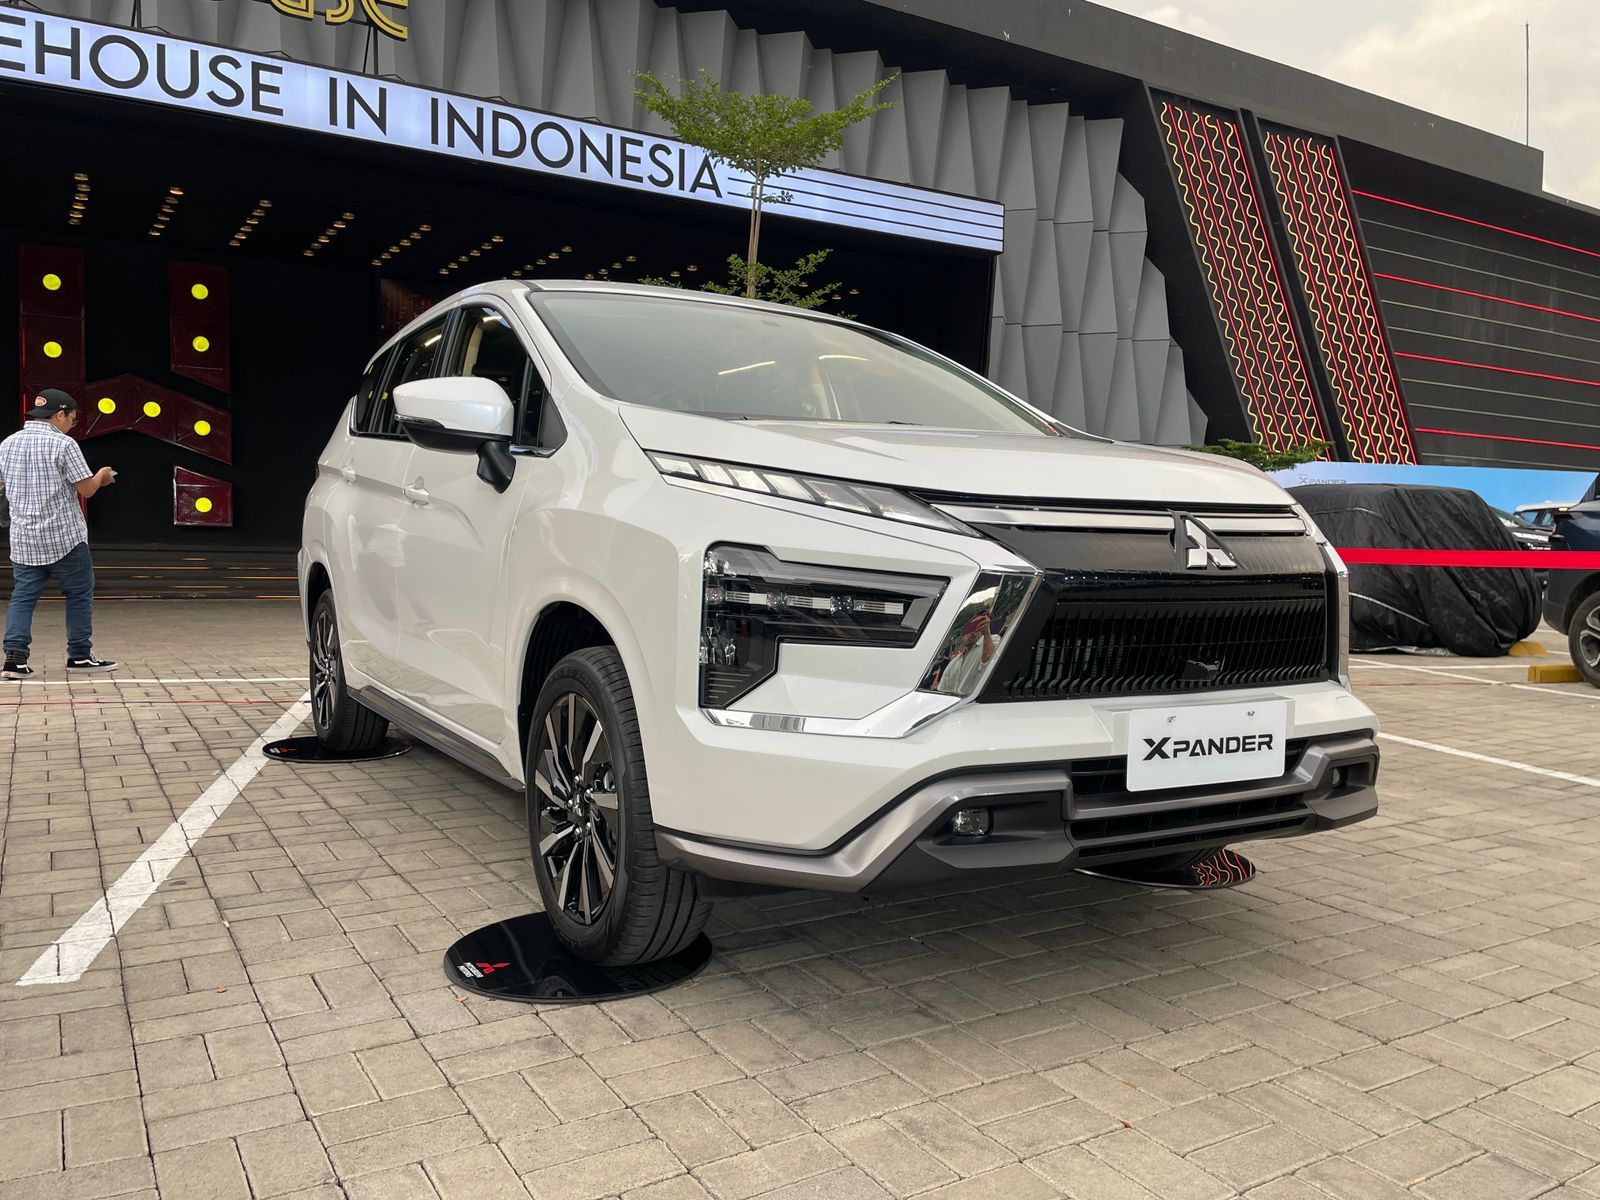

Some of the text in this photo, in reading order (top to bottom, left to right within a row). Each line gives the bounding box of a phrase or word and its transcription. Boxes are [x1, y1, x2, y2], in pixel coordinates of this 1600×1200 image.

[328, 76, 388, 136] IN
[431, 97, 722, 198] INDONESIA
[1142, 733, 1274, 762] XPANDER
